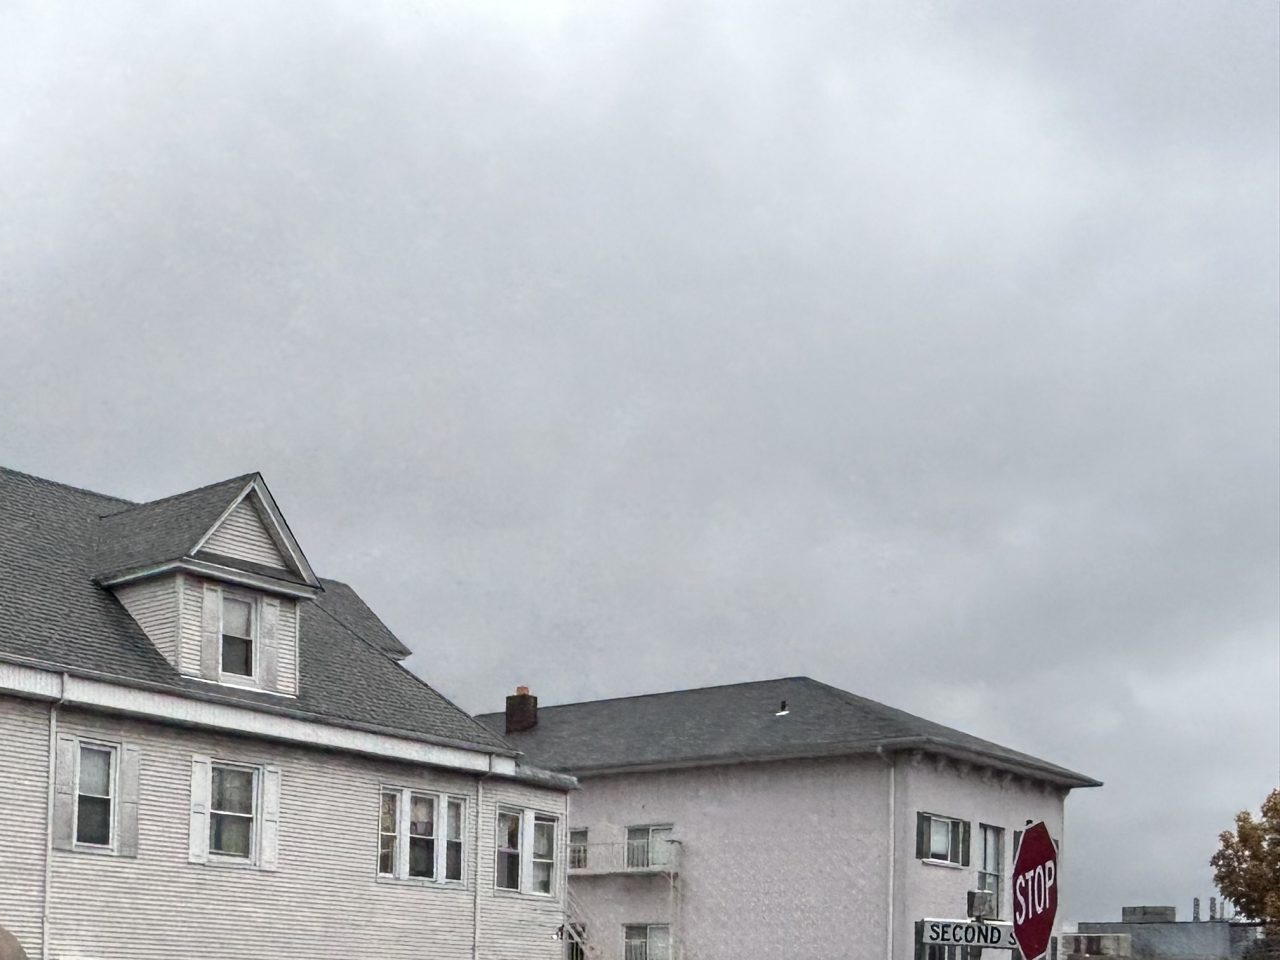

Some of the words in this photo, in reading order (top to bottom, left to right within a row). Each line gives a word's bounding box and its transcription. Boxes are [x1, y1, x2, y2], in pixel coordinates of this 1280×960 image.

[1015, 860, 1056, 926] STOP
[929, 923, 1001, 945] SECOND
[1008, 931, 1018, 946] S
